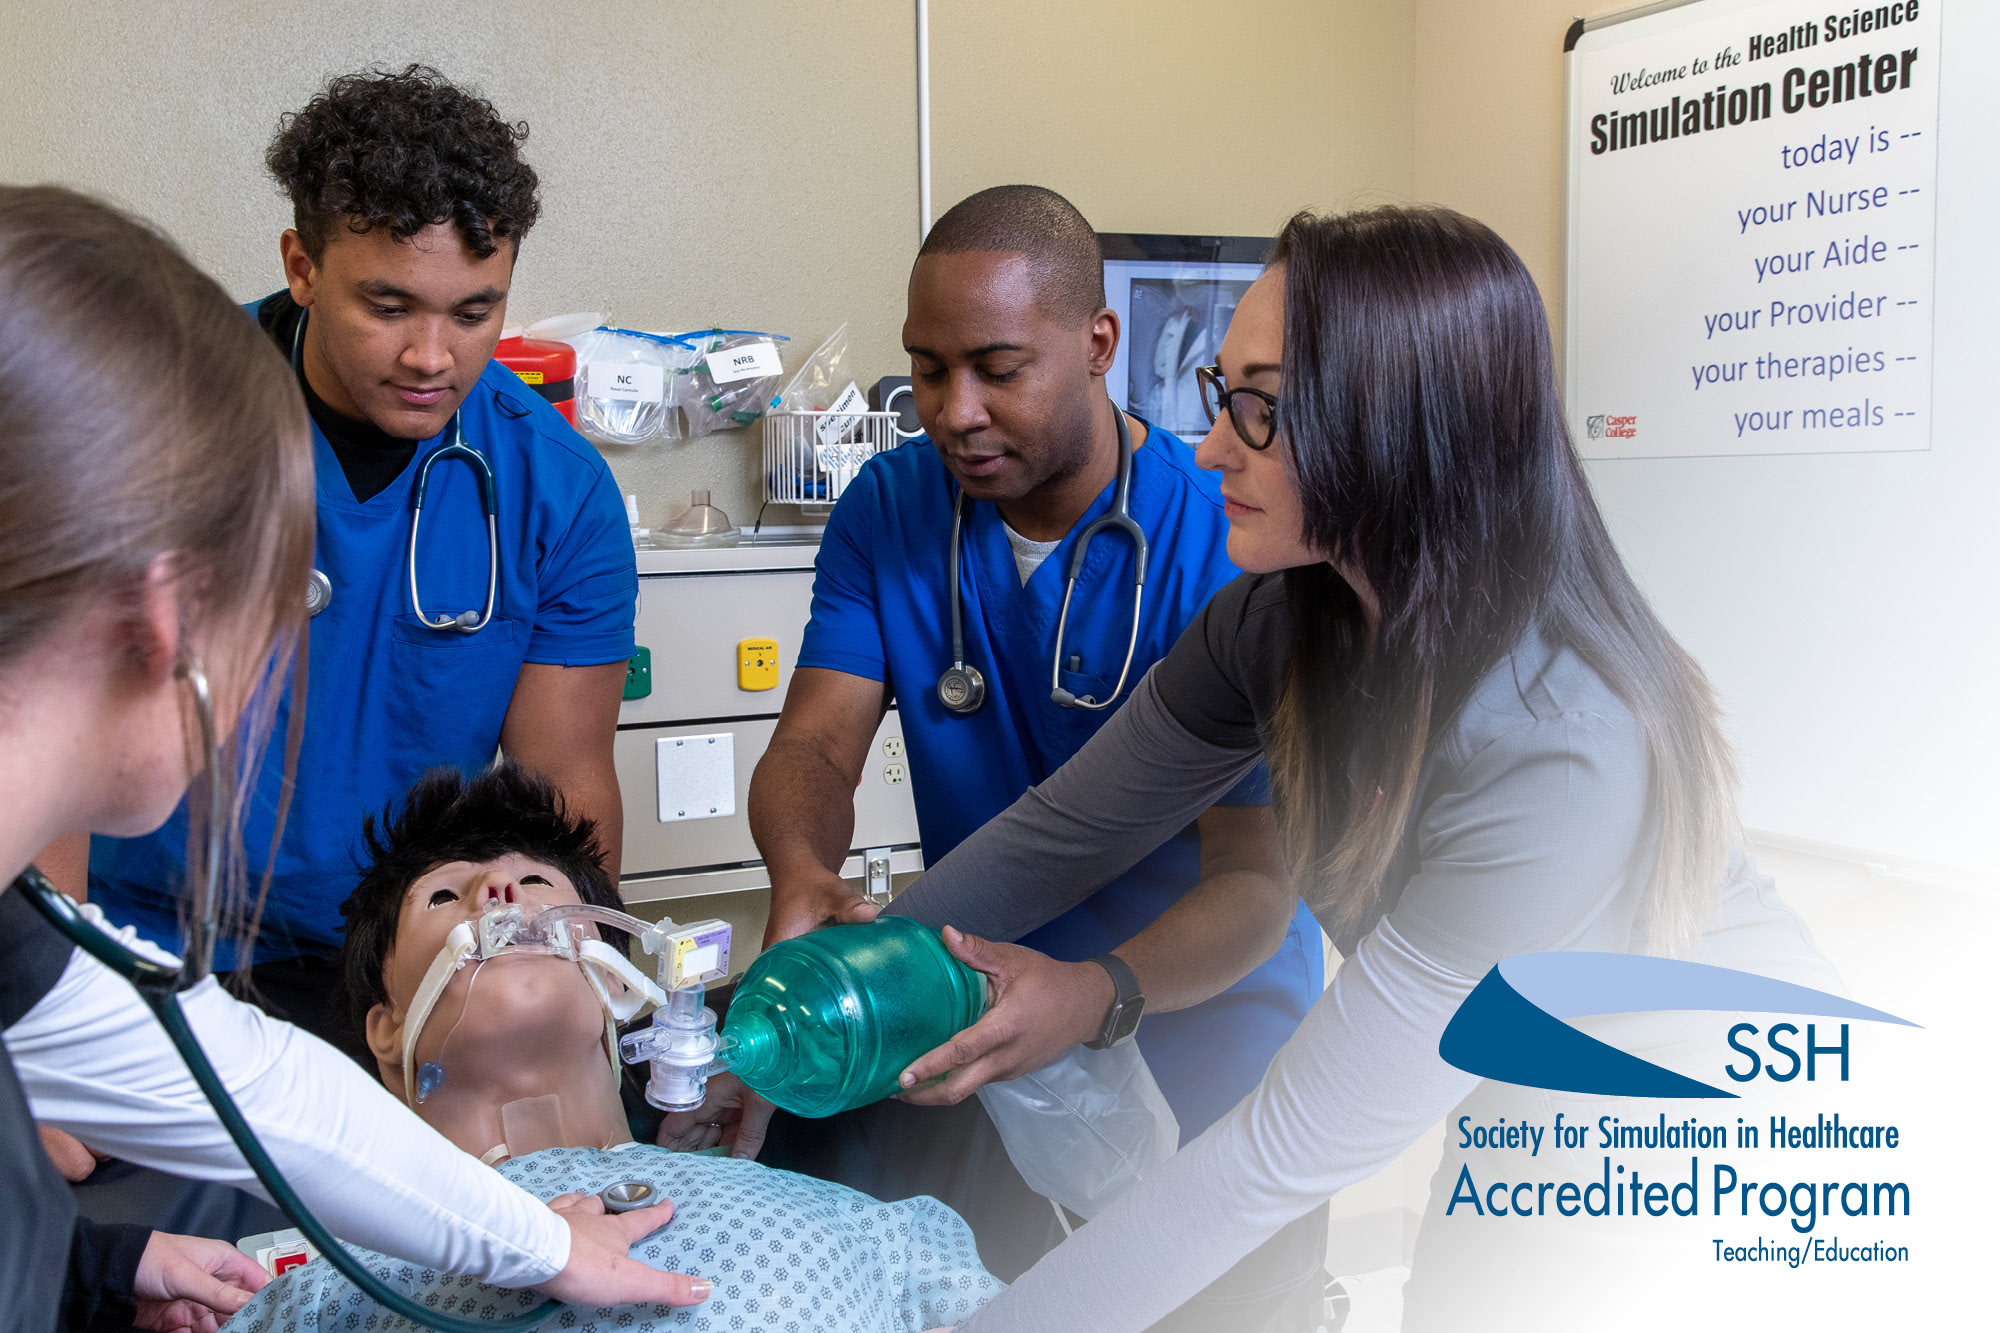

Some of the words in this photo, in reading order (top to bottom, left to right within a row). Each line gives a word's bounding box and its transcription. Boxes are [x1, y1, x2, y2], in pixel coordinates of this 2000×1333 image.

[1611, 65, 1687, 95] Welcome
[1691, 57, 1709, 76] to
[1714, 46, 1741, 70] the
[1748, 22, 1818, 62] Health
[1824, 0, 1919, 43] Science
[1590, 82, 1772, 155] Simulation
[1782, 47, 1919, 114] Center
[1781, 134, 1860, 169] today
[1870, 125, 1890, 154] is
[1737, 201, 1797, 235] your
[1806, 186, 1888, 219] Nurse
[1754, 250, 1816, 284] your
[1823, 235, 1887, 268] Aide
[1704, 308, 1762, 340] your
[1770, 291, 1887, 327] Provider
[617, 375, 632, 384] NC
[733, 355, 755, 366] NRB
[1691, 360, 1748, 391] your
[1755, 347, 1886, 382] therapies
[1605, 426, 1636, 439] College
[1606, 415, 1637, 428] Casper
[1734, 410, 1794, 438] your
[1802, 398, 1884, 430] meals
